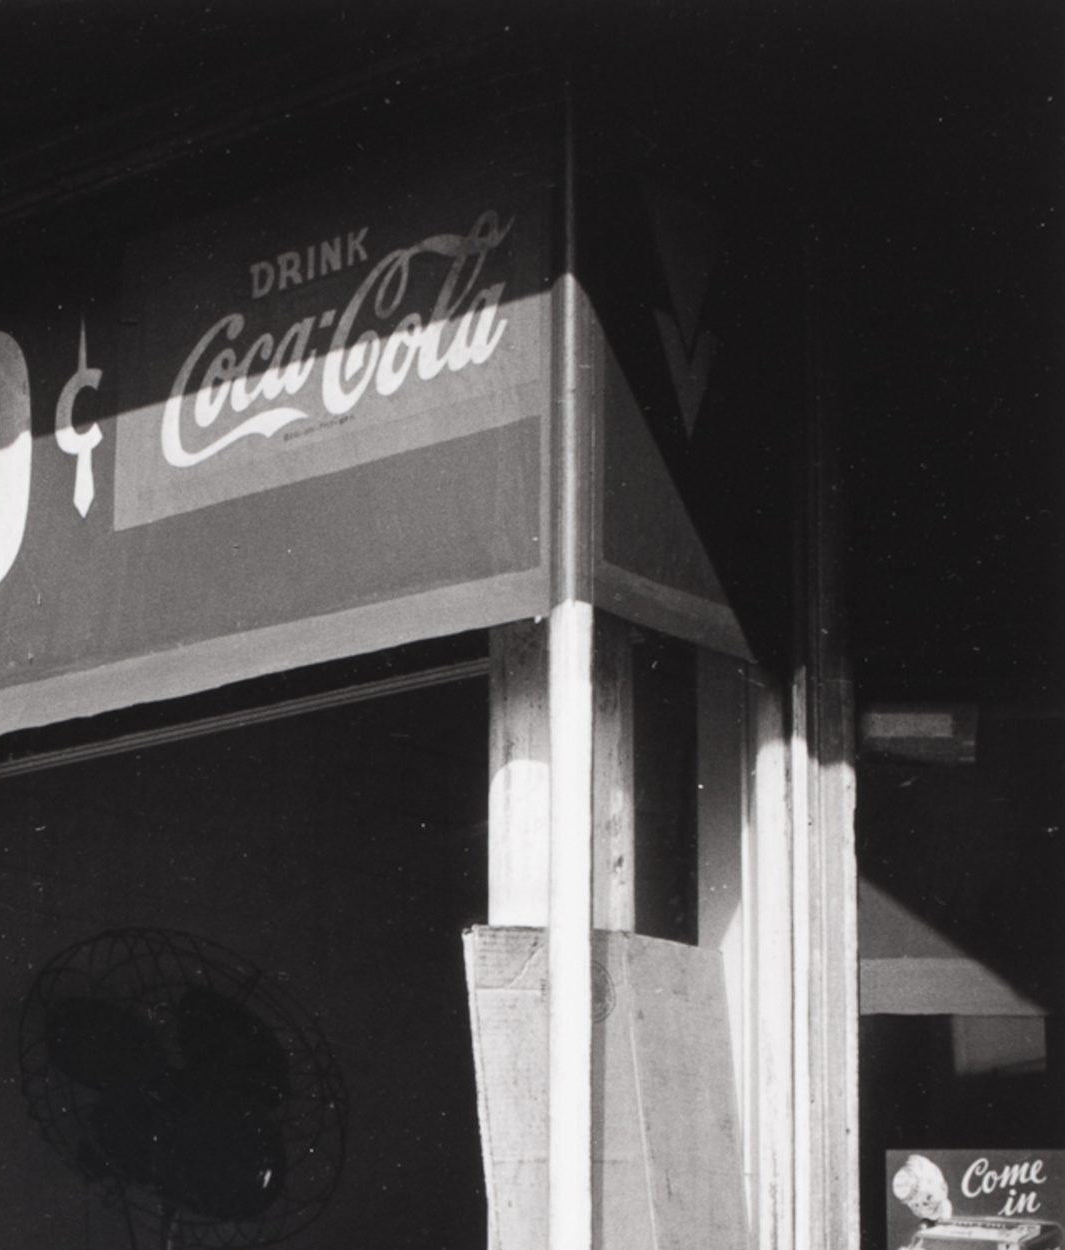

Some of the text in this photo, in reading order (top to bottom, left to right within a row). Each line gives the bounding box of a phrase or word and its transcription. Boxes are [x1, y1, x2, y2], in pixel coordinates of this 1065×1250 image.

[249, 226, 369, 298] DRINK
[161, 209, 516, 468] Coca-Cola
[960, 1157, 1047, 1198] Come
[997, 1188, 1041, 1217] in
